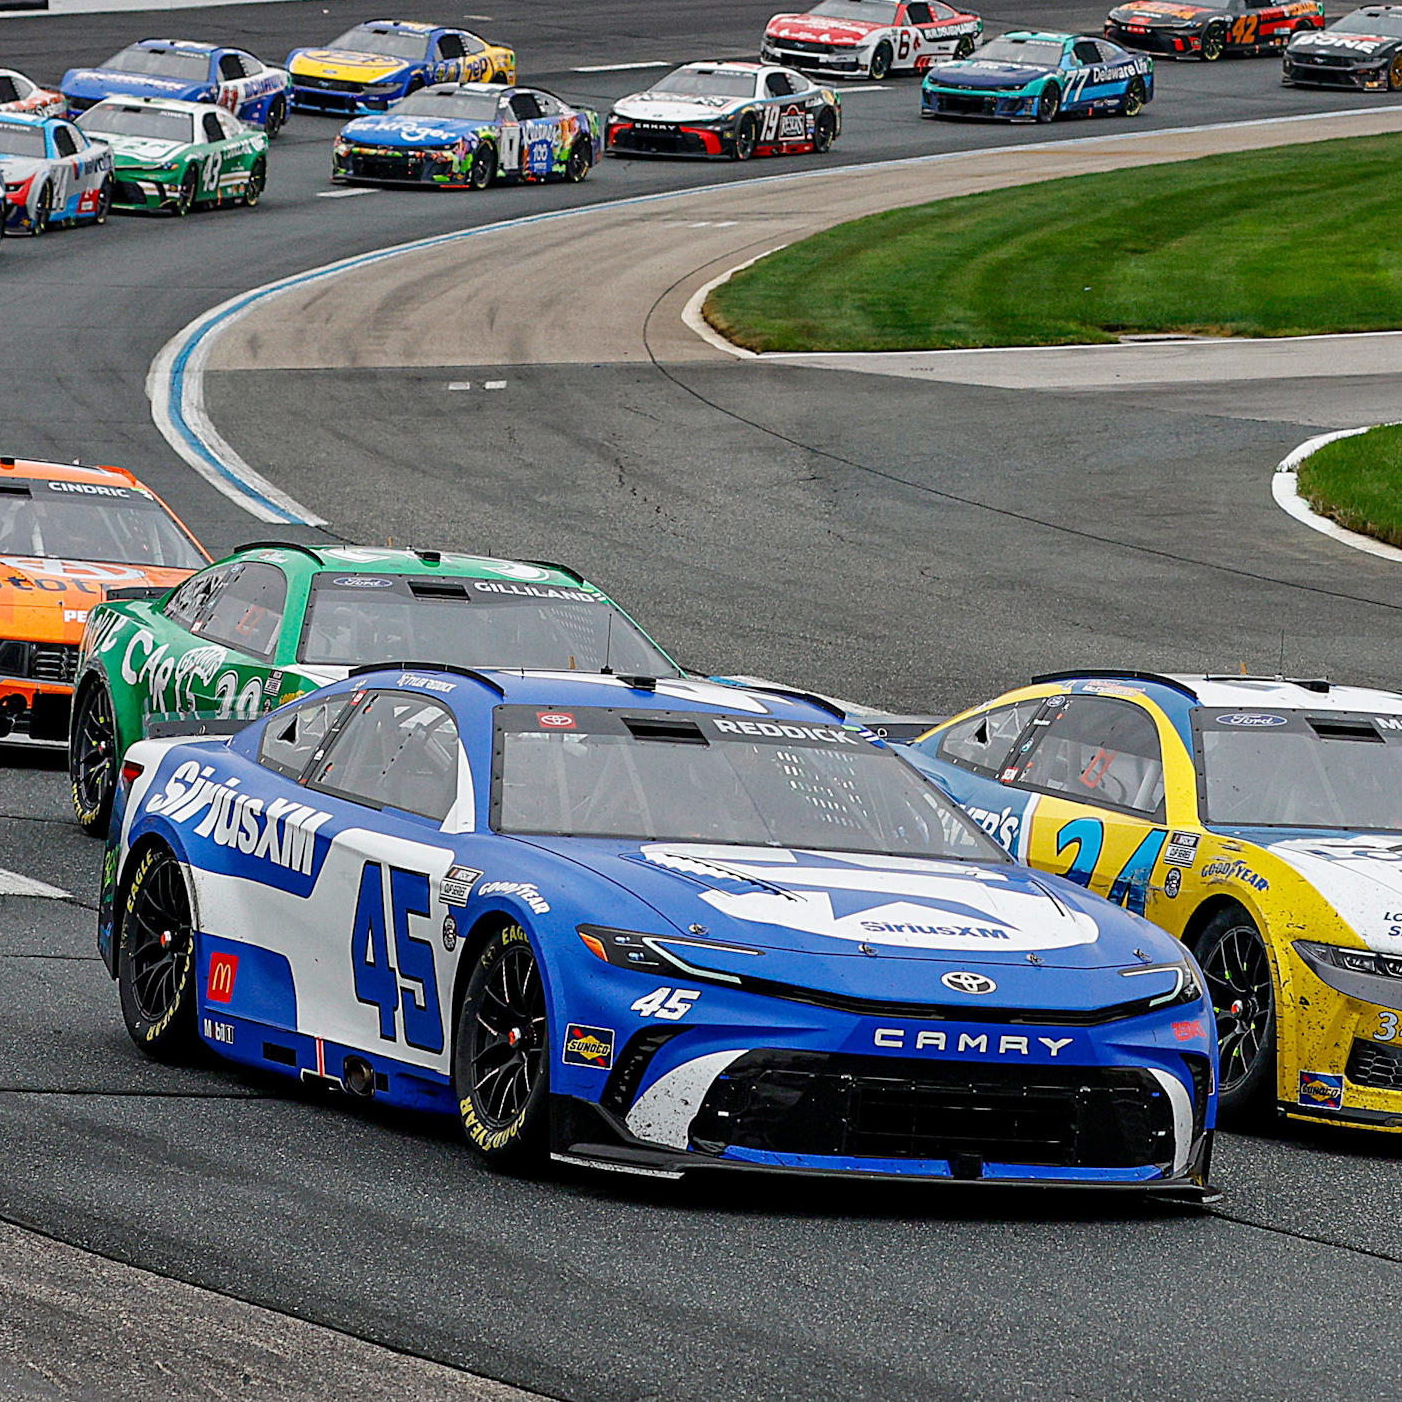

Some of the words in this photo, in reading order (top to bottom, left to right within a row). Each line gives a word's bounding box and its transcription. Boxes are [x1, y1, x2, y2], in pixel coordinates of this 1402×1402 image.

[1232, 14, 1258, 44] 42
[898, 30, 911, 59] 6
[1295, 36, 1381, 54] BONE
[1093, 59, 1135, 83] Delaware
[1062, 70, 1090, 103] 77
[375, 121, 456, 142] Kroger
[634, 122, 676, 130] CAMRY
[760, 106, 781, 141] 19
[202, 153, 223, 192] 43
[48, 481, 130, 498] CINDRIC
[474, 581, 597, 603] GILLILAND
[713, 719, 859, 746] REDDICK
[1233, 713, 1274, 727] Ford
[145, 761, 333, 877] SiriusXM
[126, 848, 153, 914] EAGLE
[1201, 860, 1270, 892] GOODYEAR
[478, 882, 551, 915] GOODYEAR
[860, 920, 1010, 940] SiriusXM
[351, 859, 445, 1054] 45
[630, 987, 701, 1020] 45
[567, 1038, 611, 1056] SUNOCO
[874, 1029, 1074, 1057] CAMRY
